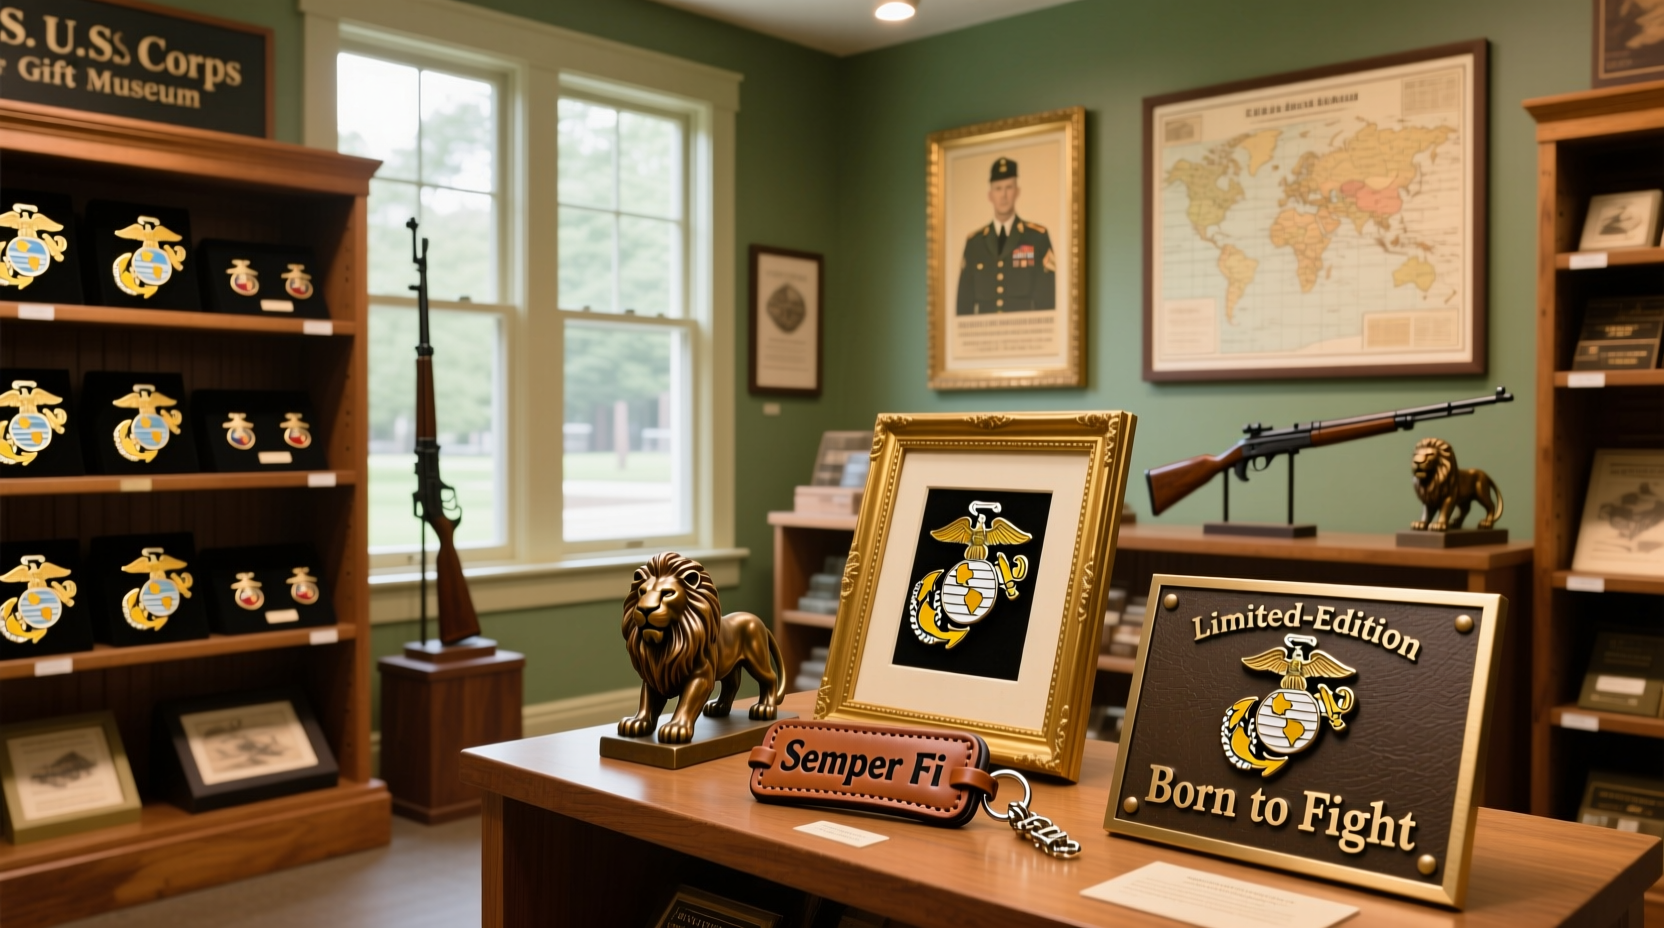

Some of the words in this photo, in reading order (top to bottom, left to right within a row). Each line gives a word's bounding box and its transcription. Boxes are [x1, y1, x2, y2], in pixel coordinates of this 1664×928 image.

[18, 56, 76, 88] Gift
[87, 68, 201, 109] Museum
[138, 36, 242, 92] Corps
[1192, 602, 1421, 662] Limited-Edition
[780, 739, 903, 786] Semper
[909, 752, 946, 787] Fi
[1145, 764, 1236, 818] Born
[1250, 788, 1289, 827] to
[1298, 791, 1417, 854] Fight
